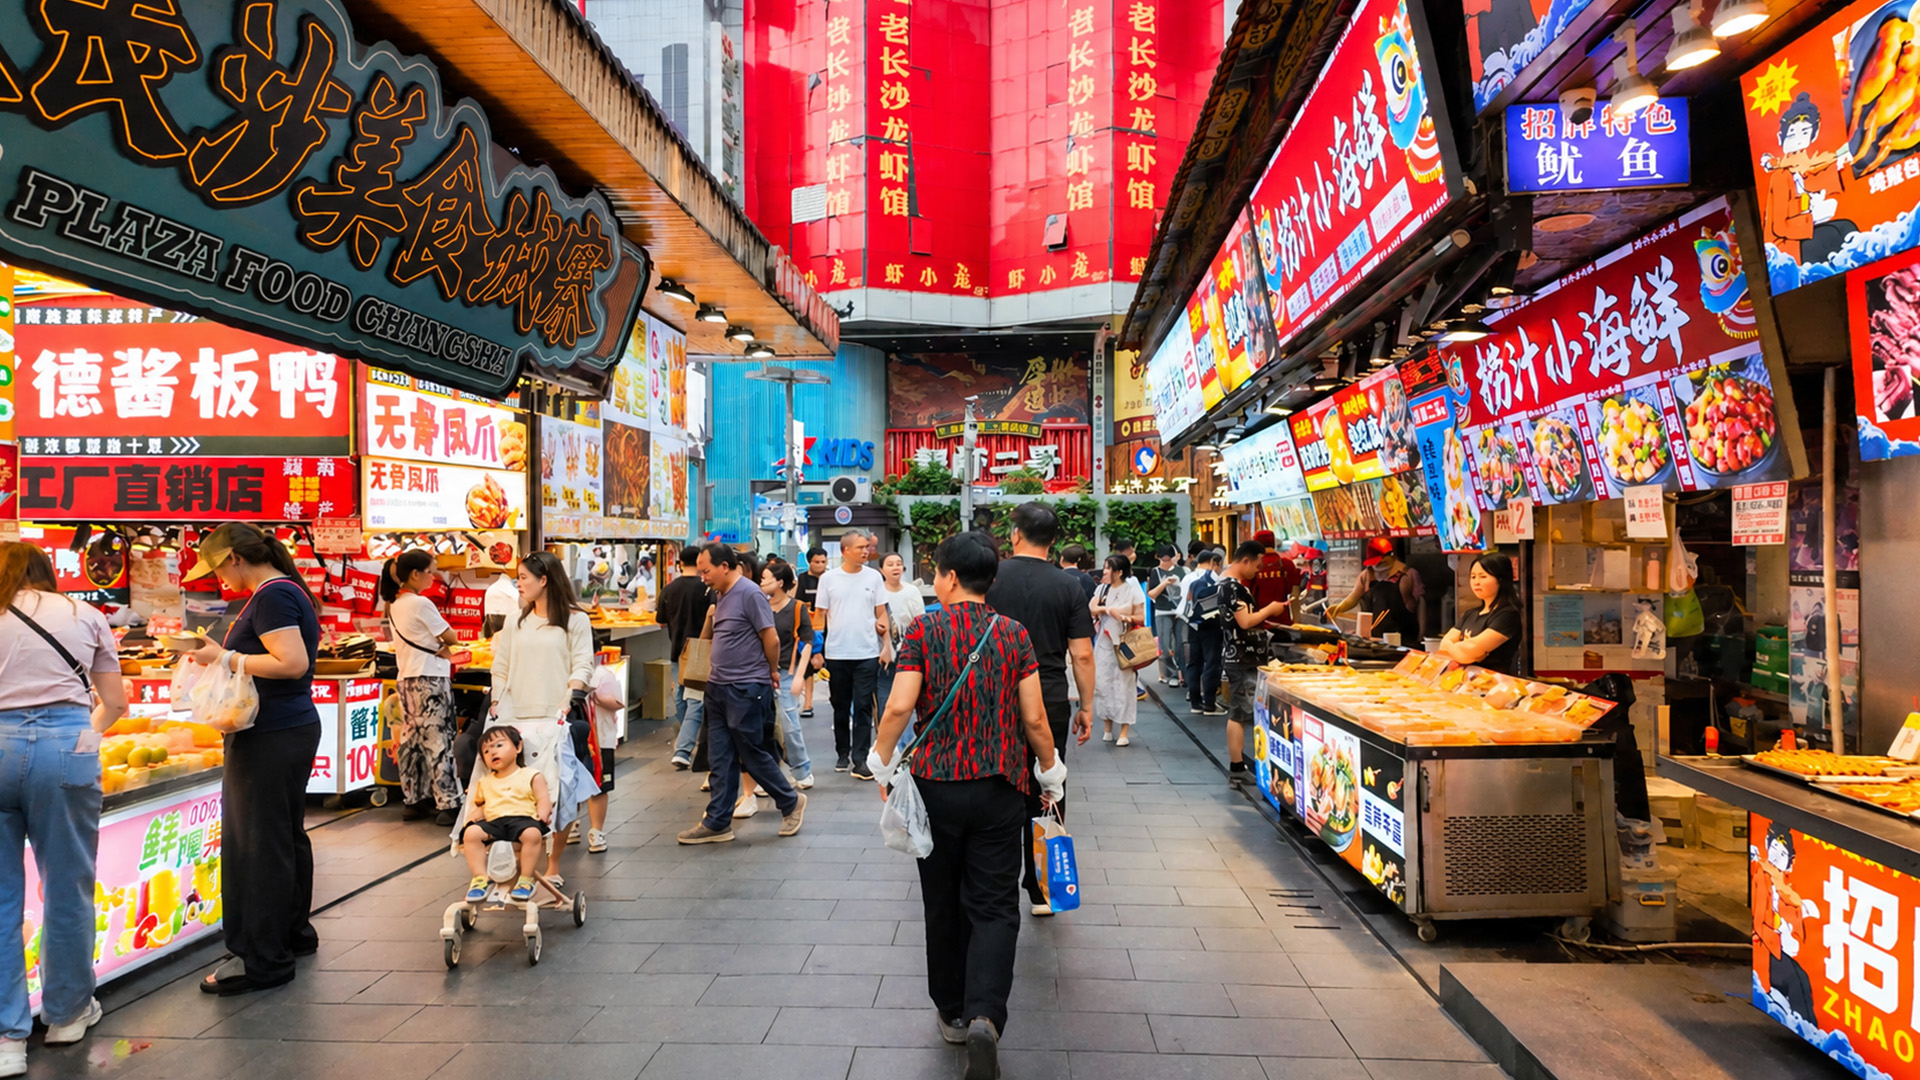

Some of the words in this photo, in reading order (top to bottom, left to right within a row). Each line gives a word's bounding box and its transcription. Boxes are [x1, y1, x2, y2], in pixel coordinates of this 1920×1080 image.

[826, 15, 851, 217] 老长沙龙虾馆
[878, 12, 910, 218] 老长沙龙虾馆
[1066, 5, 1095, 212] 老长沙龙虾馆
[1126, 2, 1157, 210] 老长沙龙虾馆
[1275, 69, 1388, 282] 捞汁小海鲜
[1535, 137, 1664, 187] 鱿鱼
[12, 170, 224, 282] PLAZA
[225, 245, 353, 322] FOOD
[355, 296, 512, 378] CHANGSHA
[1474, 255, 1691, 416] 捞汁小海鲜
[15, 347, 339, 419] 德酱板鸭
[374, 394, 498, 463] 无骨凤爪
[818, 437, 875, 471] KIDS
[20, 464, 265, 513] 工厂直销店
[370, 461, 440, 494] 无骨凤爪
[1822, 864, 1920, 1035] 招
[1822, 985, 1915, 1064] ZHAO
